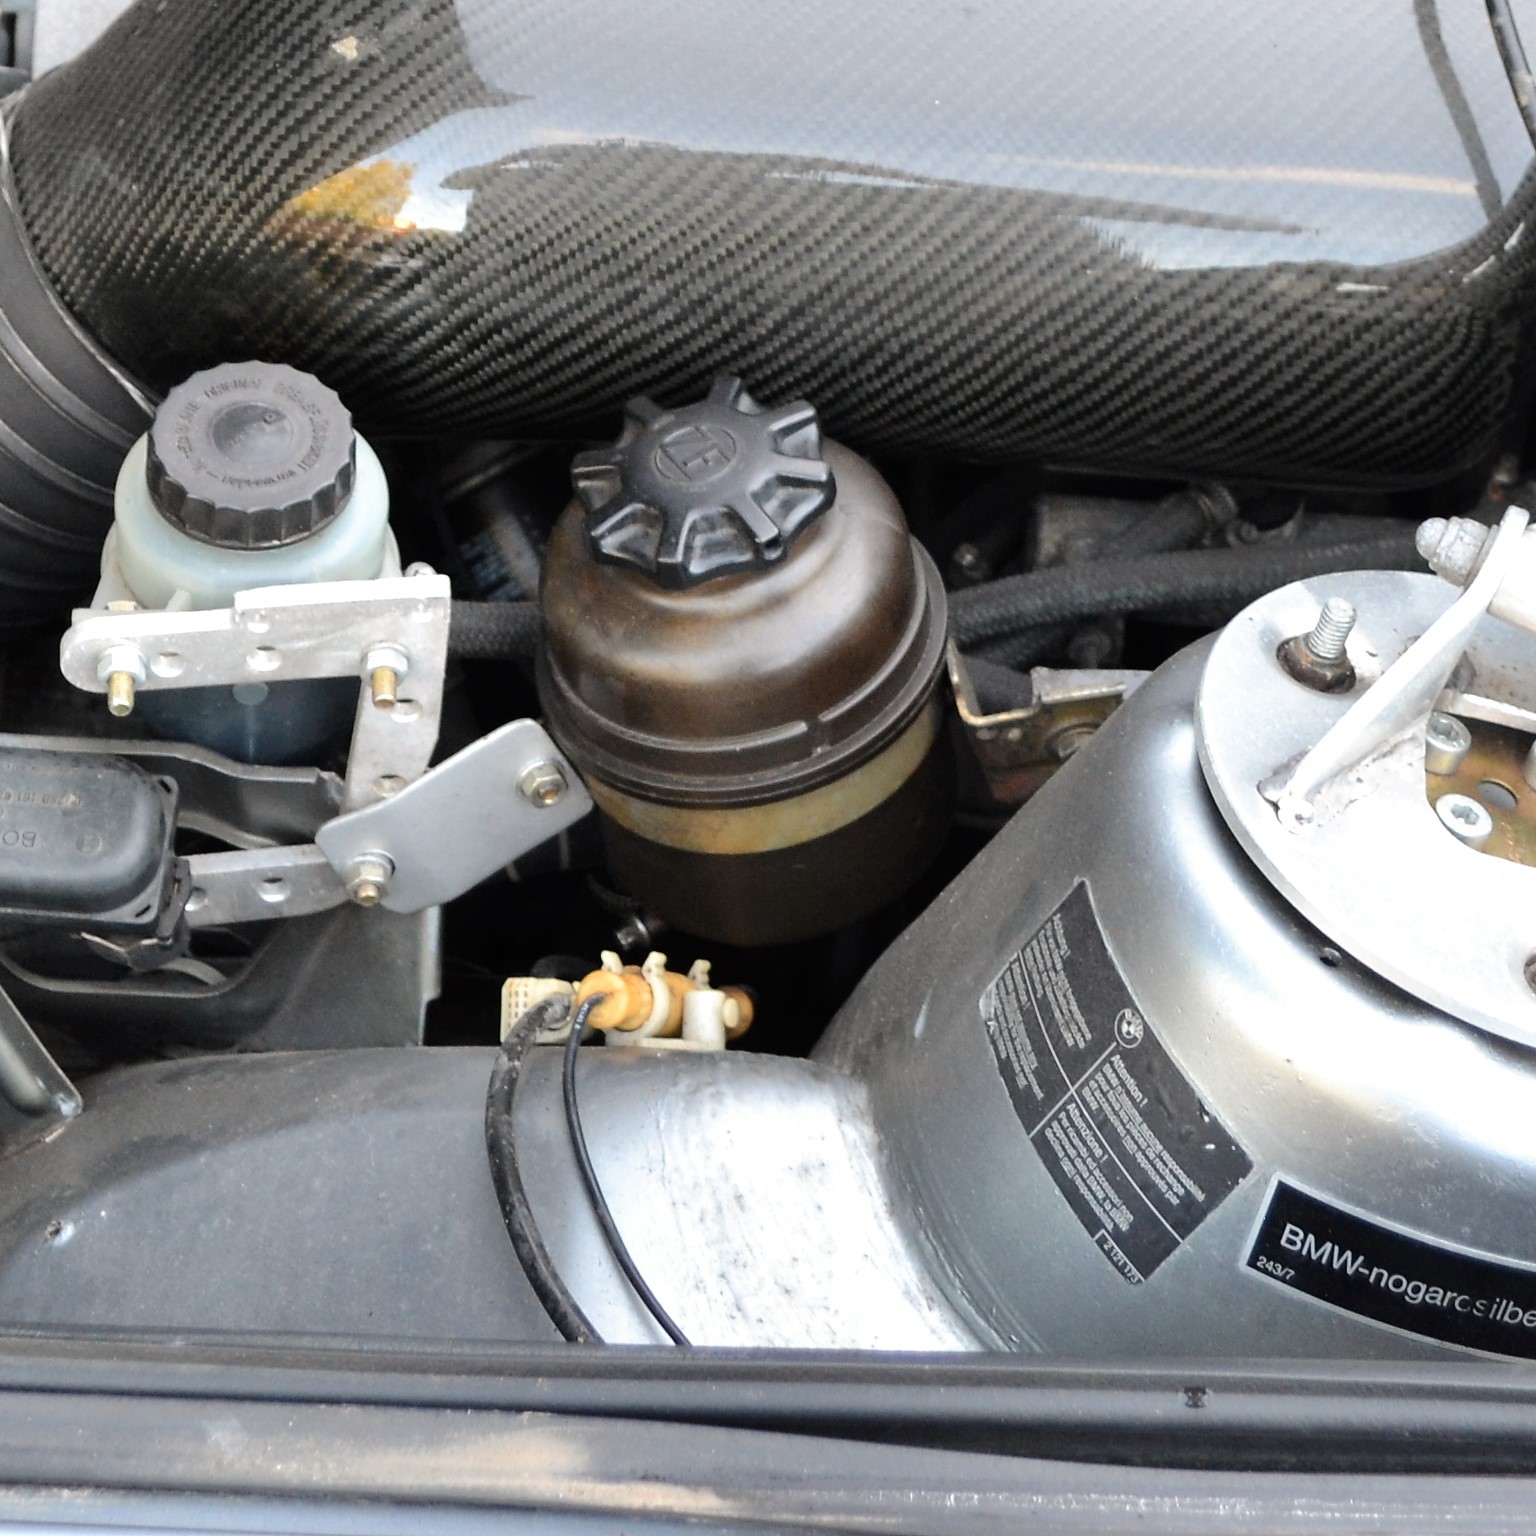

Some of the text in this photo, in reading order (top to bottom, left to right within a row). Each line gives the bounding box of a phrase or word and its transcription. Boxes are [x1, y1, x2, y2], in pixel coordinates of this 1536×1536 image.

[659, 426, 732, 480] ZF
[1111, 1053, 1144, 1103] Attention
[1066, 1102, 1104, 1159] Attenzione
[1103, 1240, 1114, 1252] 2
[1109, 1248, 1126, 1267] 121
[1256, 1256, 1296, 1281] 243/7
